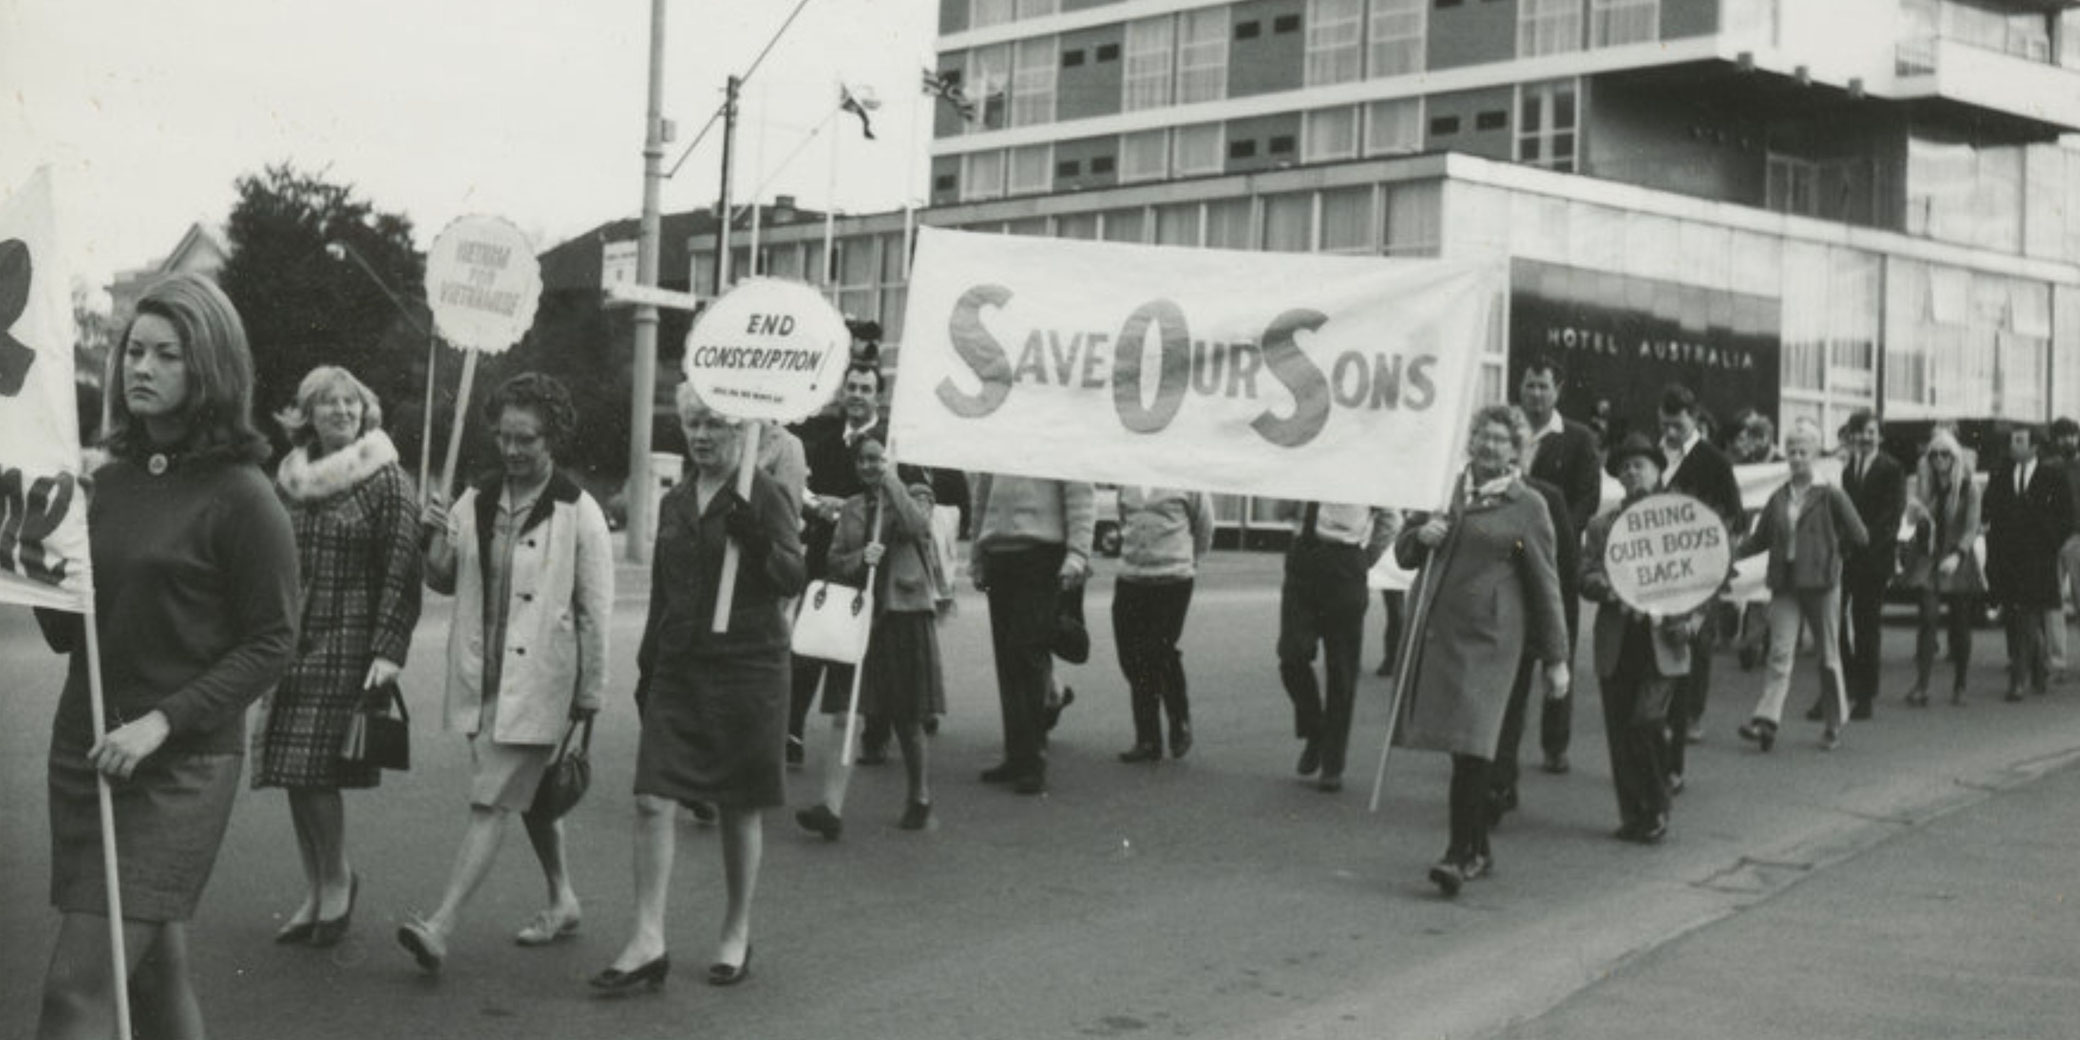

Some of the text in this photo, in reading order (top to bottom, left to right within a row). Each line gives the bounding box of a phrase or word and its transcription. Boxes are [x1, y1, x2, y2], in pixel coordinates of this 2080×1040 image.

[746, 313, 796, 337] END
[1548, 326, 1752, 369] HOTEL AUSTRALIA
[1627, 502, 1696, 533] BRING
[1609, 526, 1721, 564] OUR BOYS
[1637, 557, 1695, 587] BACK
